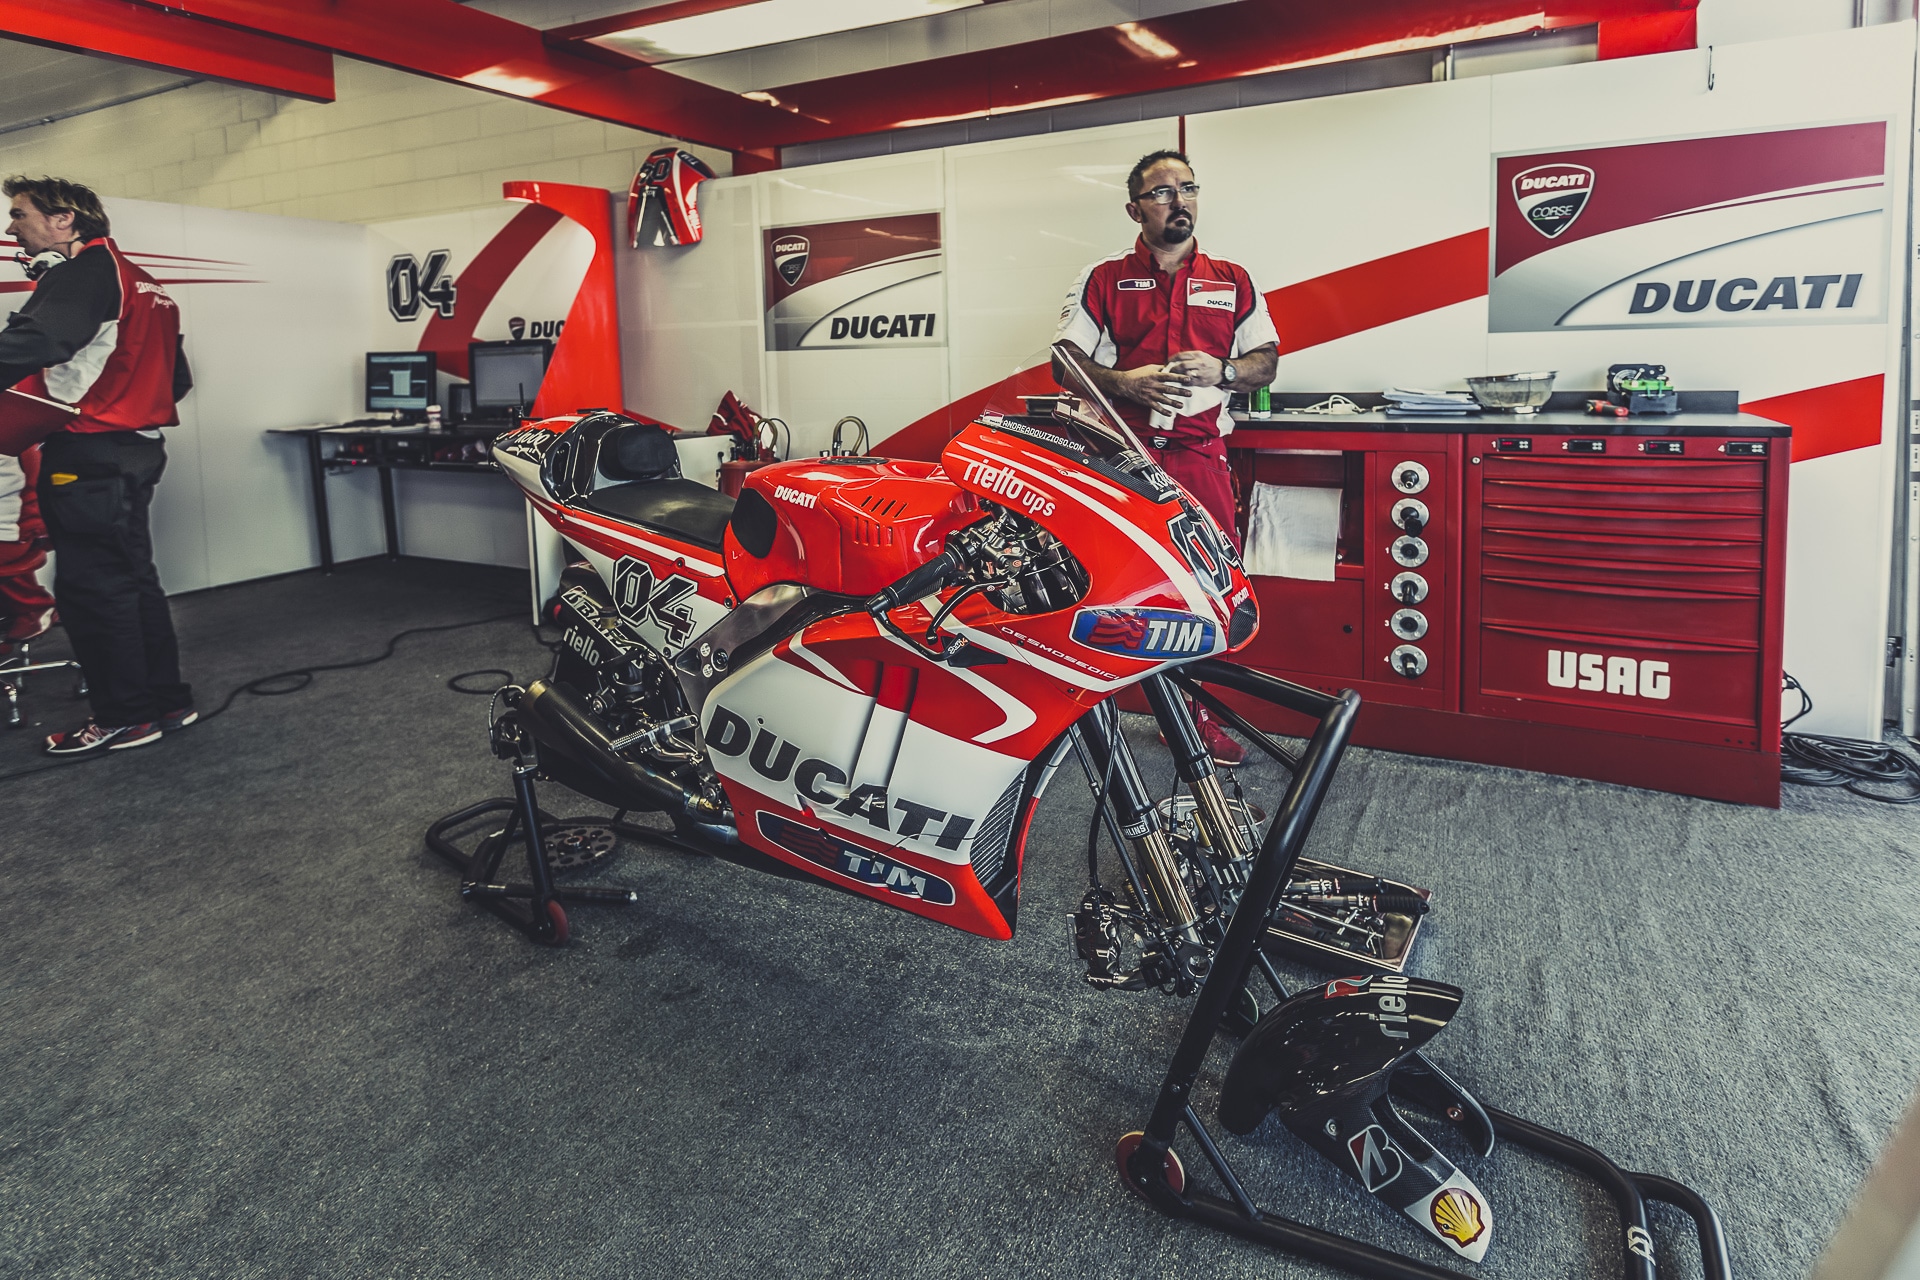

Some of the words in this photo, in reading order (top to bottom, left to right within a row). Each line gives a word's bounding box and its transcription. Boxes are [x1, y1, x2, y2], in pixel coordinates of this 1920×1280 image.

[1520, 173, 1585, 190] DUCATI
[1531, 204, 1574, 218] CORSE
[775, 242, 806, 253] DUCATI
[386, 248, 457, 322] 04
[1134, 280, 1151, 288] TIM
[1206, 299, 1233, 308] DUCATI
[1628, 273, 1863, 314] DUCATI
[830, 313, 936, 340] DUCATI
[774, 484, 818, 510] DUCATI
[963, 458, 1024, 500] riello
[1022, 491, 1057, 517] ups
[612, 554, 698, 650] 04
[563, 625, 600, 667] riello
[1000, 626, 1120, 680] DESMOSEDICI
[1144, 620, 1203, 652] TIM
[1547, 649, 1671, 700] USAG
[703, 703, 976, 852] DUCATI
[843, 849, 927, 897] TIM
[1368, 975, 1410, 1039] riello
